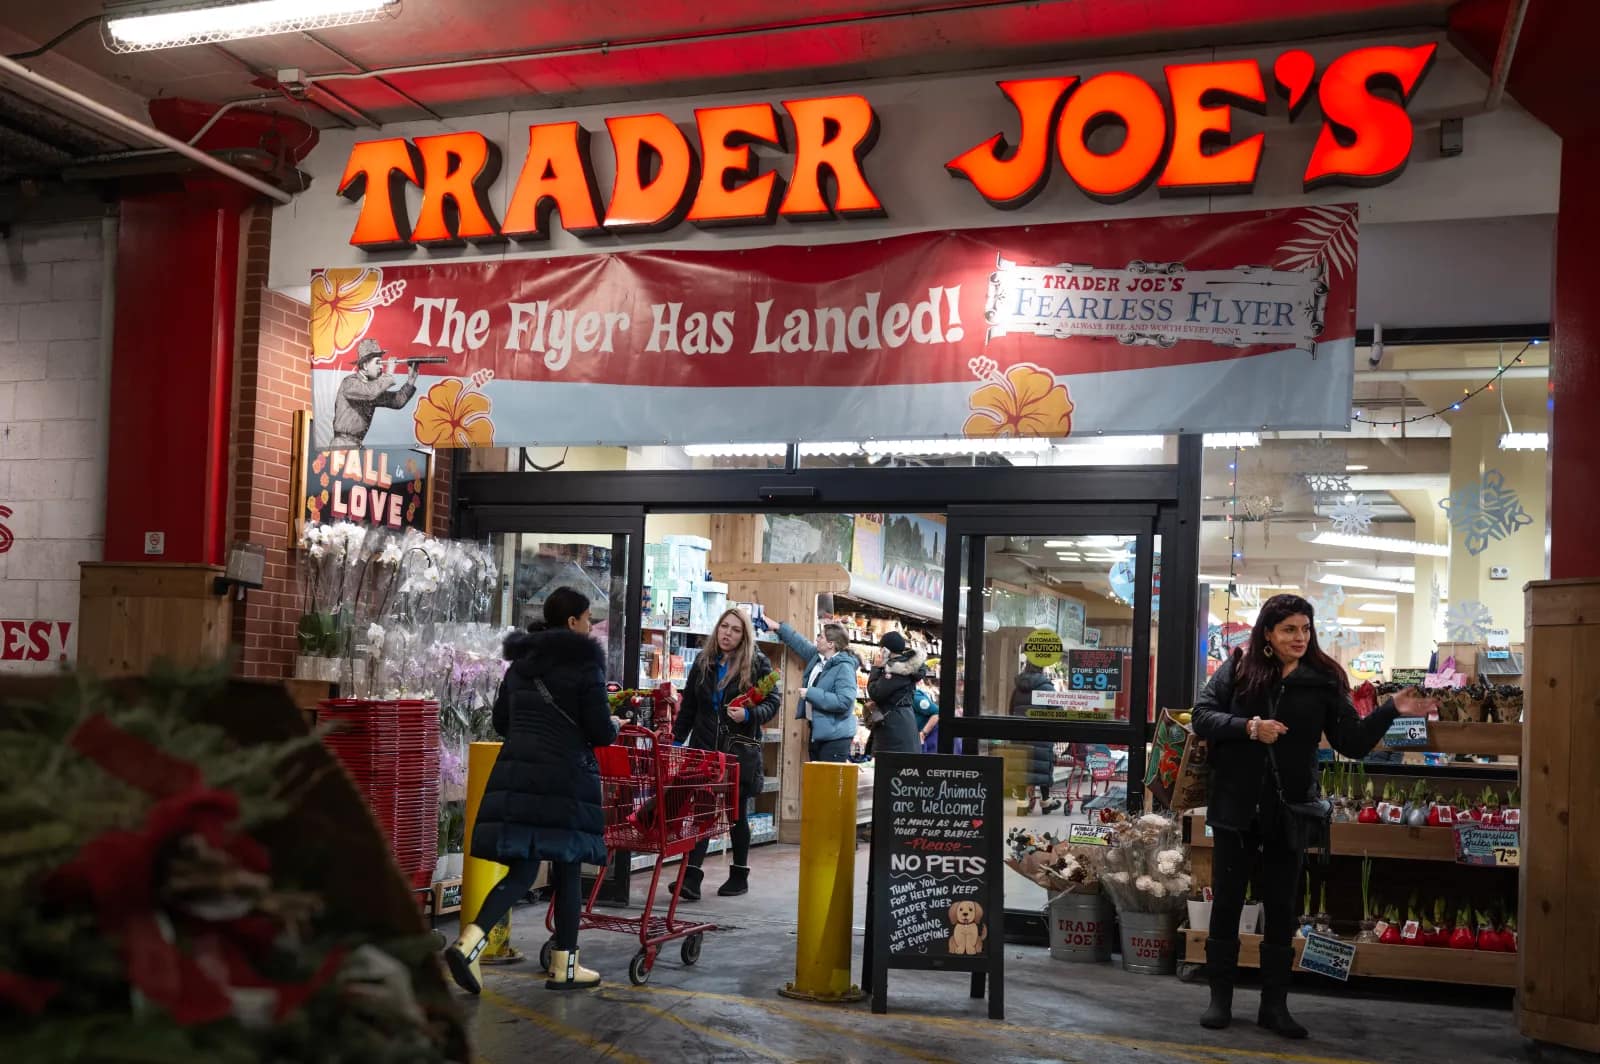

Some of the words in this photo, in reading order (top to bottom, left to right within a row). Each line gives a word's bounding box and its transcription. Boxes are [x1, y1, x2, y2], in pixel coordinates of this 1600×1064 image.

[337, 94, 885, 247] TRADER
[944, 42, 1437, 203] JOE'S
[1043, 275, 1120, 291] TRADER
[1126, 277, 1185, 292] JOE'S
[1012, 287, 1173, 321] FEARLESS
[1186, 291, 1295, 326] FLYER
[412, 297, 490, 354] The
[504, 300, 630, 371] Flyer
[645, 302, 735, 356] Has
[750, 285, 964, 354] Landed!
[1150, 324, 1182, 332] WORTH
[1184, 325, 1209, 333] EVERY
[330, 449, 393, 489] FALL
[331, 480, 404, 529] LOVE
[900, 768, 919, 776] ADA
[926, 769, 979, 778] CERTIFIED
[890, 777, 935, 797] Service
[935, 780, 987, 800] Animals
[893, 801, 916, 813] are
[921, 799, 984, 816] Welcome!
[894, 827, 917, 836] YOUR
[921, 828, 941, 837] FUR
[907, 818, 935, 826] MUCH
[936, 819, 950, 827] AS
[953, 820, 970, 828] WE
[891, 854, 921, 871] NO
[926, 855, 987, 875] PETS
[889, 882, 917, 896] THANK
[919, 879, 936, 888] YOU
[889, 895, 907, 908] FOR
[910, 885, 949, 901] HELPING
[952, 885, 979, 895] KEEP
[891, 901, 927, 919] TRADER
[890, 918, 943, 942] WELCOMING
[897, 914, 918, 929] SAFE
[1058, 919, 1104, 933] TRADE
[889, 940, 906, 954] FOR
[907, 928, 950, 947] EVERYONE
